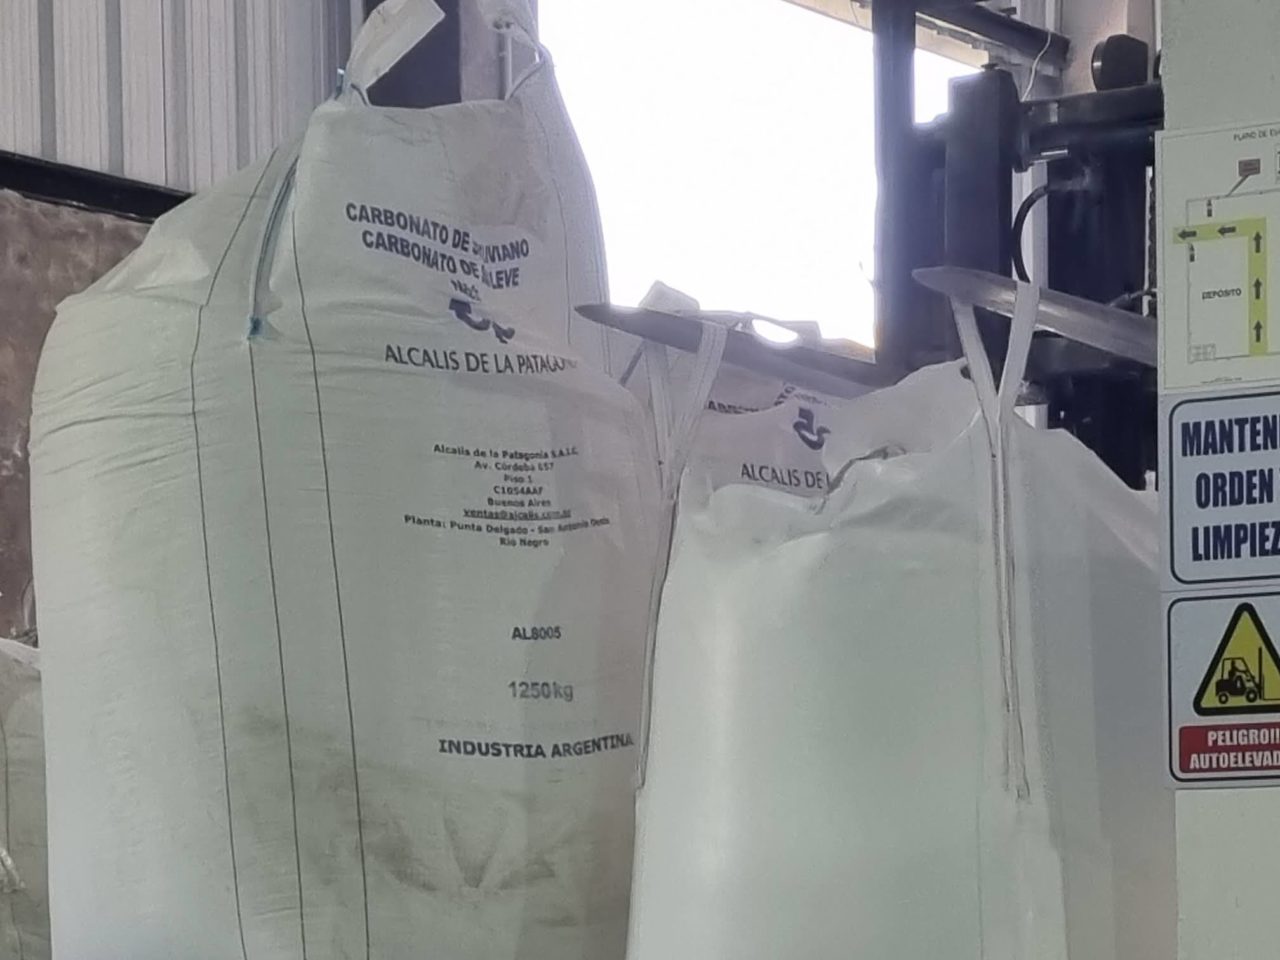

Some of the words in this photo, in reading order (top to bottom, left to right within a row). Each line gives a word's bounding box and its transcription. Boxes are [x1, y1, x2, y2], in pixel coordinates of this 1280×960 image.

[345, 202, 448, 245] CARBONATO
[452, 229, 470, 252] DE
[362, 230, 457, 275] CARBONATO
[460, 259, 480, 279] DE
[385, 344, 459, 371] ALCALIS
[465, 351, 489, 373] DE
[495, 353, 514, 374] LA
[433, 444, 471, 458] Alcalis
[473, 448, 487, 458] de
[489, 449, 499, 459] la
[502, 450, 549, 461] Patagonia
[474, 461, 492, 470] Av.
[504, 474, 525, 484] Piso
[741, 463, 800, 487] ALCALIS
[804, 471, 822, 489] DE
[1196, 468, 1274, 509] ORDEN
[487, 498, 525, 507] Buenos
[528, 497, 552, 507] Aires
[404, 515, 446, 528] Planta:
[450, 521, 482, 532] Punta
[520, 538, 549, 548] Negro
[511, 626, 562, 640] AL8005
[438, 738, 546, 758] INDUSTRIA
[551, 733, 634, 758] ARGENTINA
